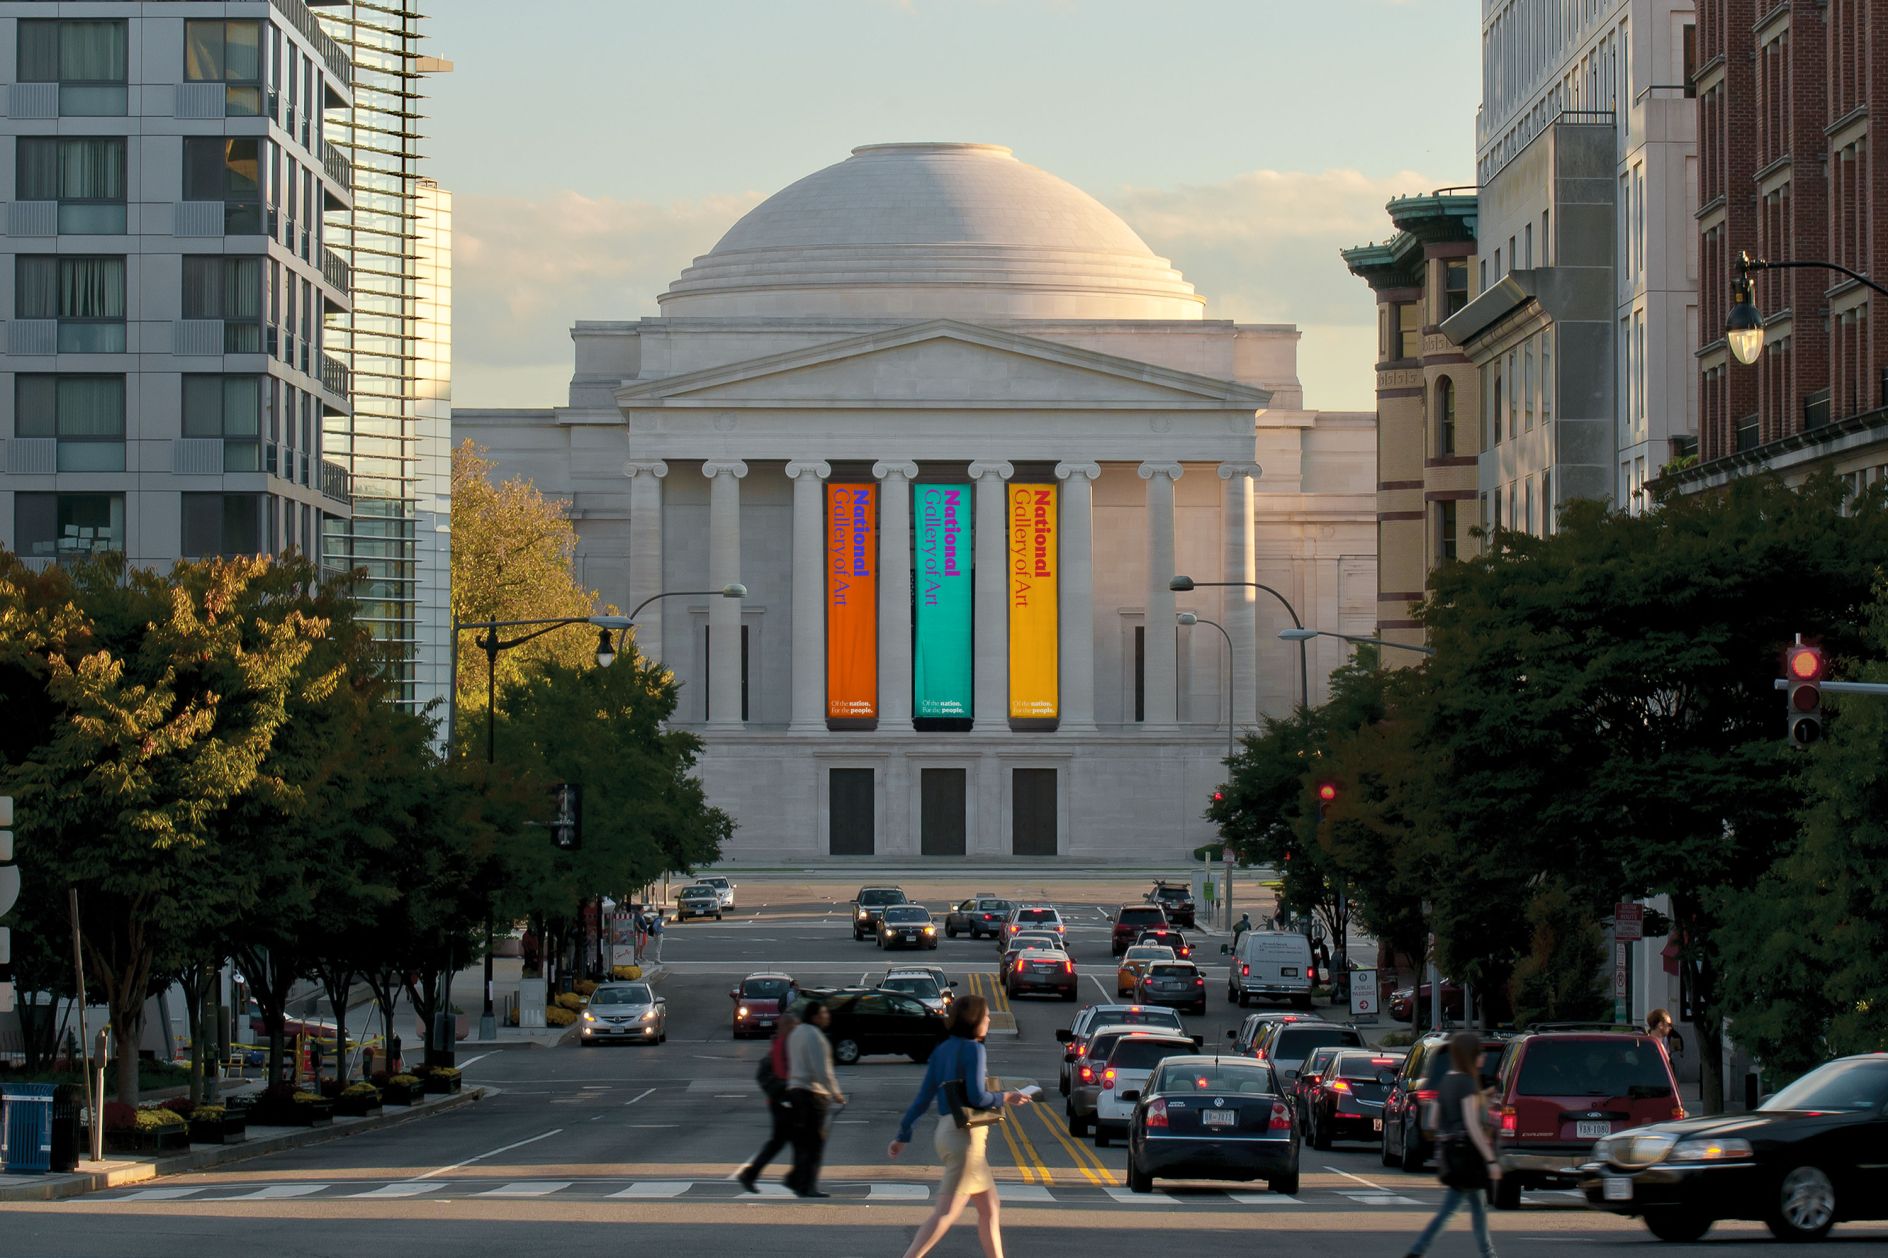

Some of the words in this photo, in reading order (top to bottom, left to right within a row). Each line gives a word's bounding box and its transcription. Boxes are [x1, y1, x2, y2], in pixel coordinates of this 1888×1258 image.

[830, 488, 850, 556] Gallery
[853, 489, 870, 577] National
[920, 489, 942, 557] Gallery
[944, 489, 961, 577] National
[1011, 489, 1031, 557] Gallery
[1034, 490, 1051, 578] National
[833, 558, 850, 577] of
[925, 558, 942, 578] of
[1015, 559, 1031, 578] of
[833, 578, 850, 606] Art
[925, 578, 941, 606] Art
[1015, 579, 1031, 608] Art
